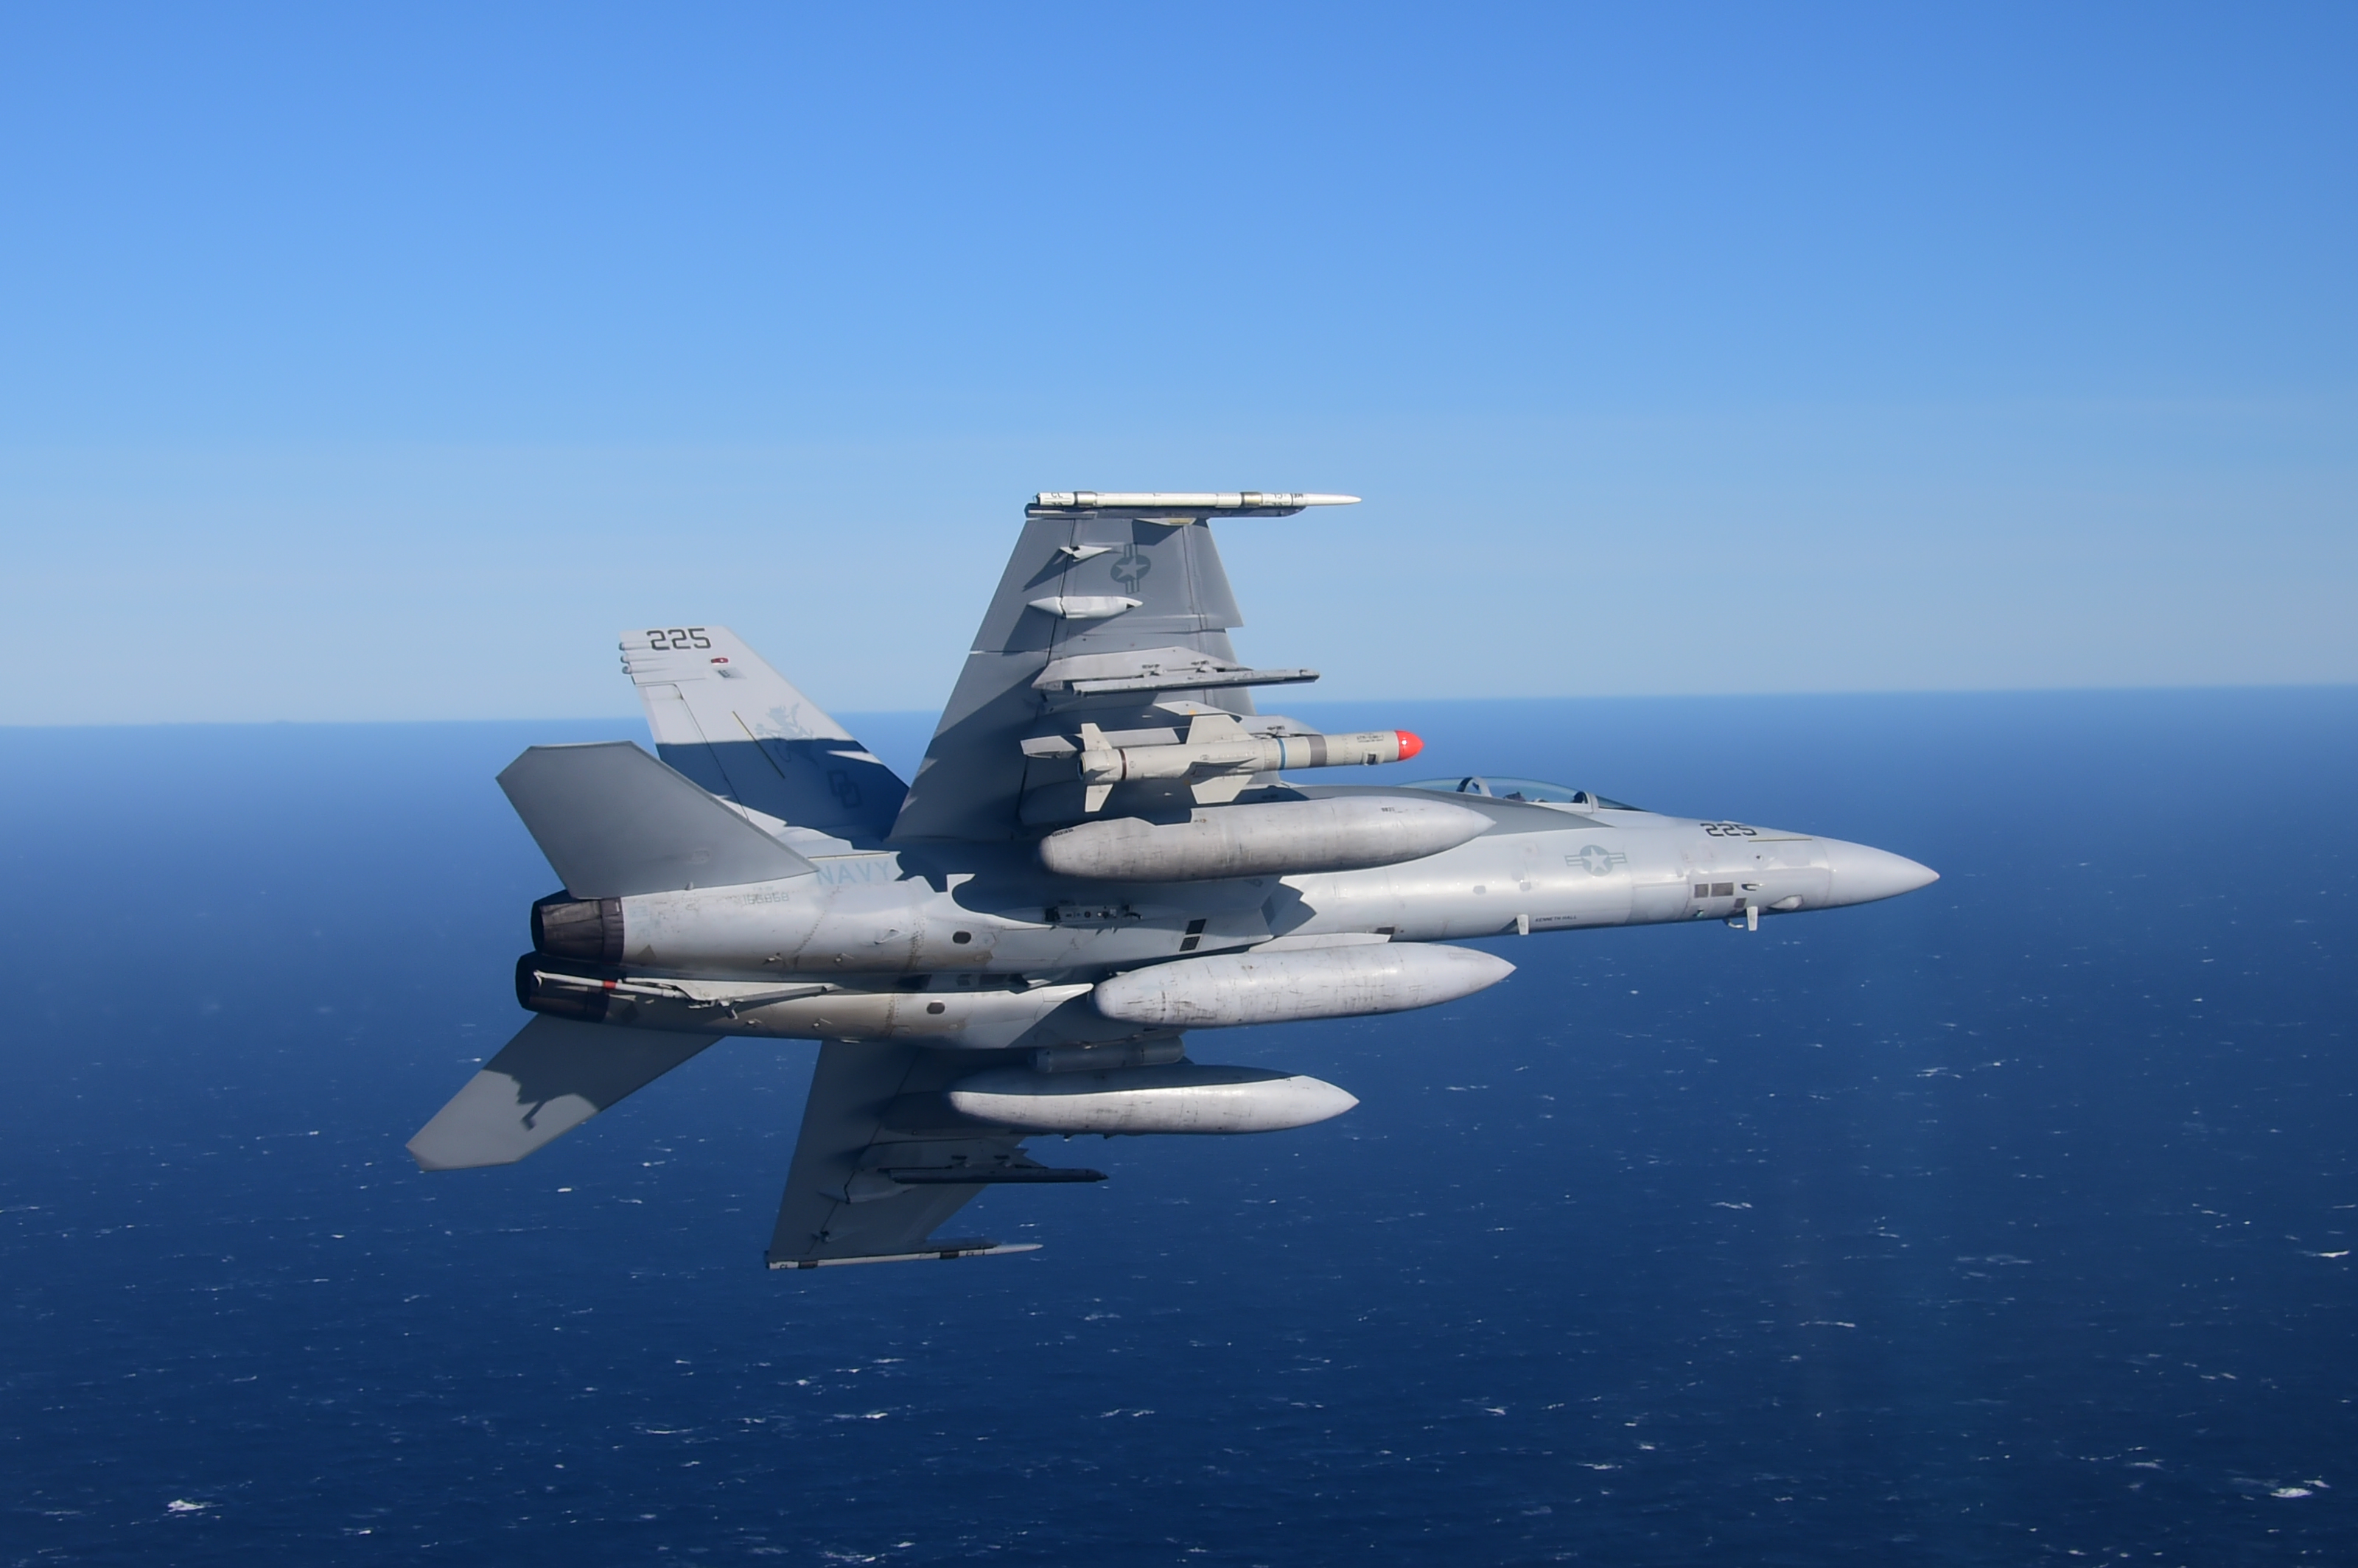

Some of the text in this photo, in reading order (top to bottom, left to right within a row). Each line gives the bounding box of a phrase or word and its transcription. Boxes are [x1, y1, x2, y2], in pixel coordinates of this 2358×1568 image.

[646, 628, 711, 651] 225
[1700, 823, 1757, 837] 225
[816, 861, 889, 885] NAVY
